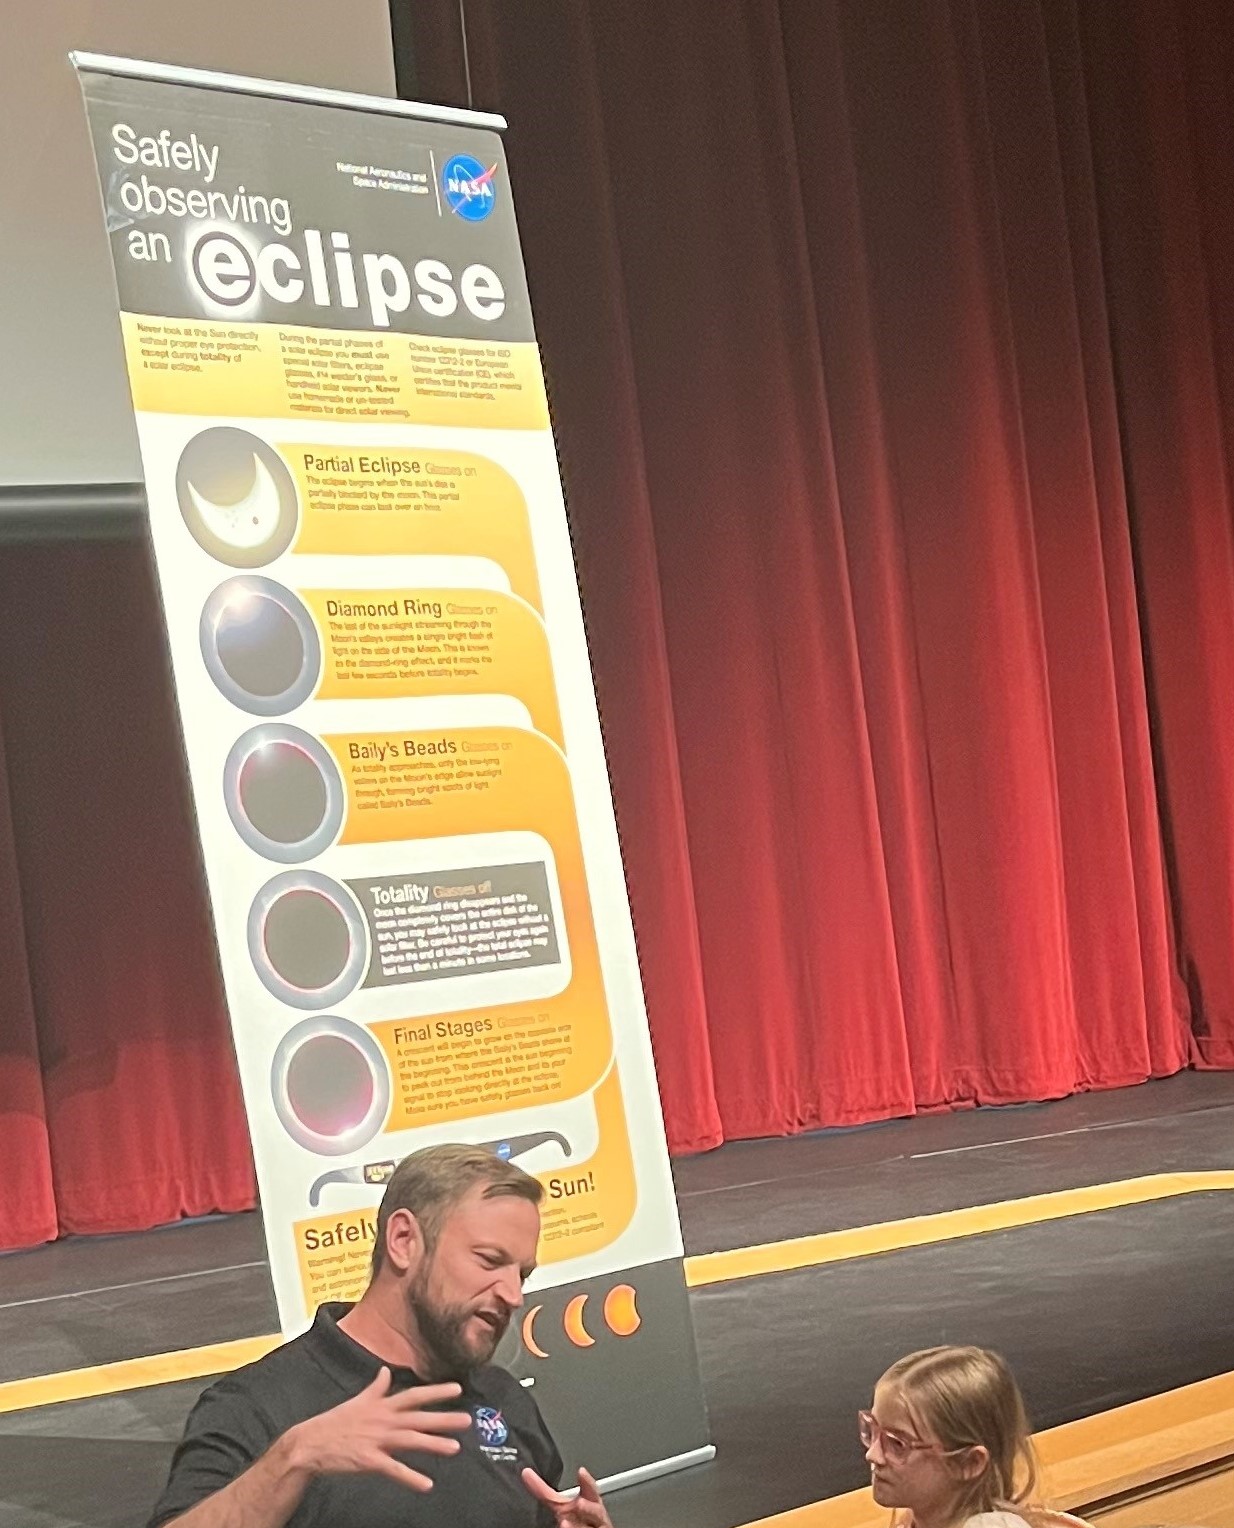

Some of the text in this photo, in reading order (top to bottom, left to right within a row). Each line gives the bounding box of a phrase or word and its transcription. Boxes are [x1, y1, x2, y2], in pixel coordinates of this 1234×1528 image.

[112, 123, 218, 182] Safely
[448, 178, 493, 196] NASA
[120, 181, 292, 234] observing
[128, 229, 505, 325] an eclipse
[304, 455, 354, 472] Partial
[359, 457, 420, 476] Eclipse
[327, 600, 398, 616] Diamond
[404, 599, 441, 618] Ring
[349, 742, 399, 761] Baily's
[404, 739, 457, 756] Beads
[370, 884, 429, 904] Totality
[394, 1027, 431, 1044] Final
[436, 1019, 492, 1038] Stages
[550, 1172, 595, 1198] Sun!
